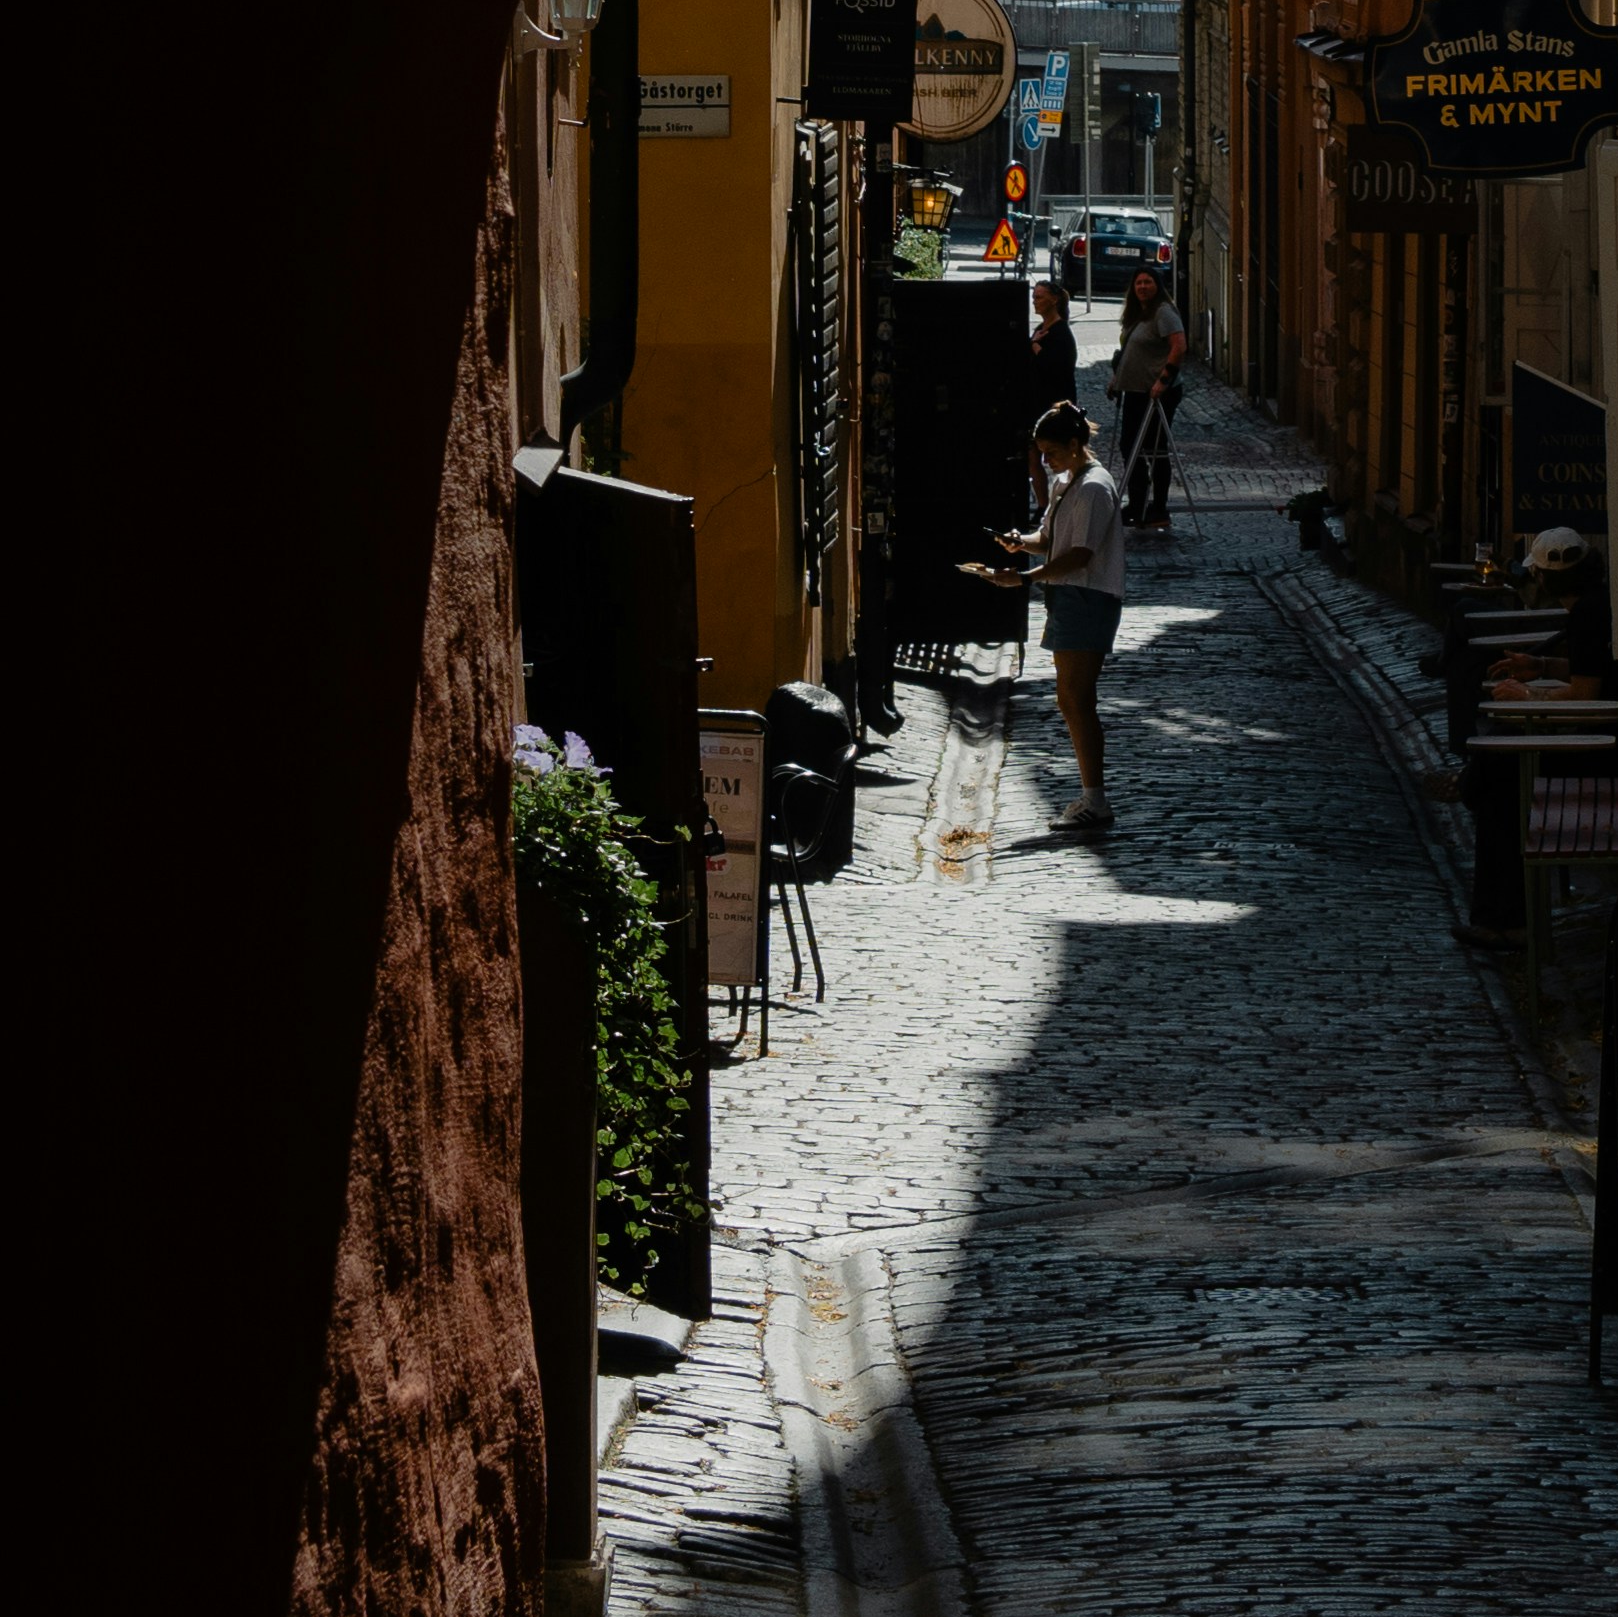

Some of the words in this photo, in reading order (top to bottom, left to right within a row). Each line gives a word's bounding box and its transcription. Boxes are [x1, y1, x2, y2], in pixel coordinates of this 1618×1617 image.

[914, 48, 997, 66] LKENNY
[1423, 30, 1498, 65] Gamla
[1507, 29, 1576, 59] Stans
[640, 81, 722, 103] Gåstorget
[1406, 66, 1602, 98] FRIMÄRKEN
[1440, 104, 1460, 128] &
[1469, 100, 1563, 127] MYNT
[1537, 462, 1607, 484] COINS
[1518, 494, 1535, 510] &
